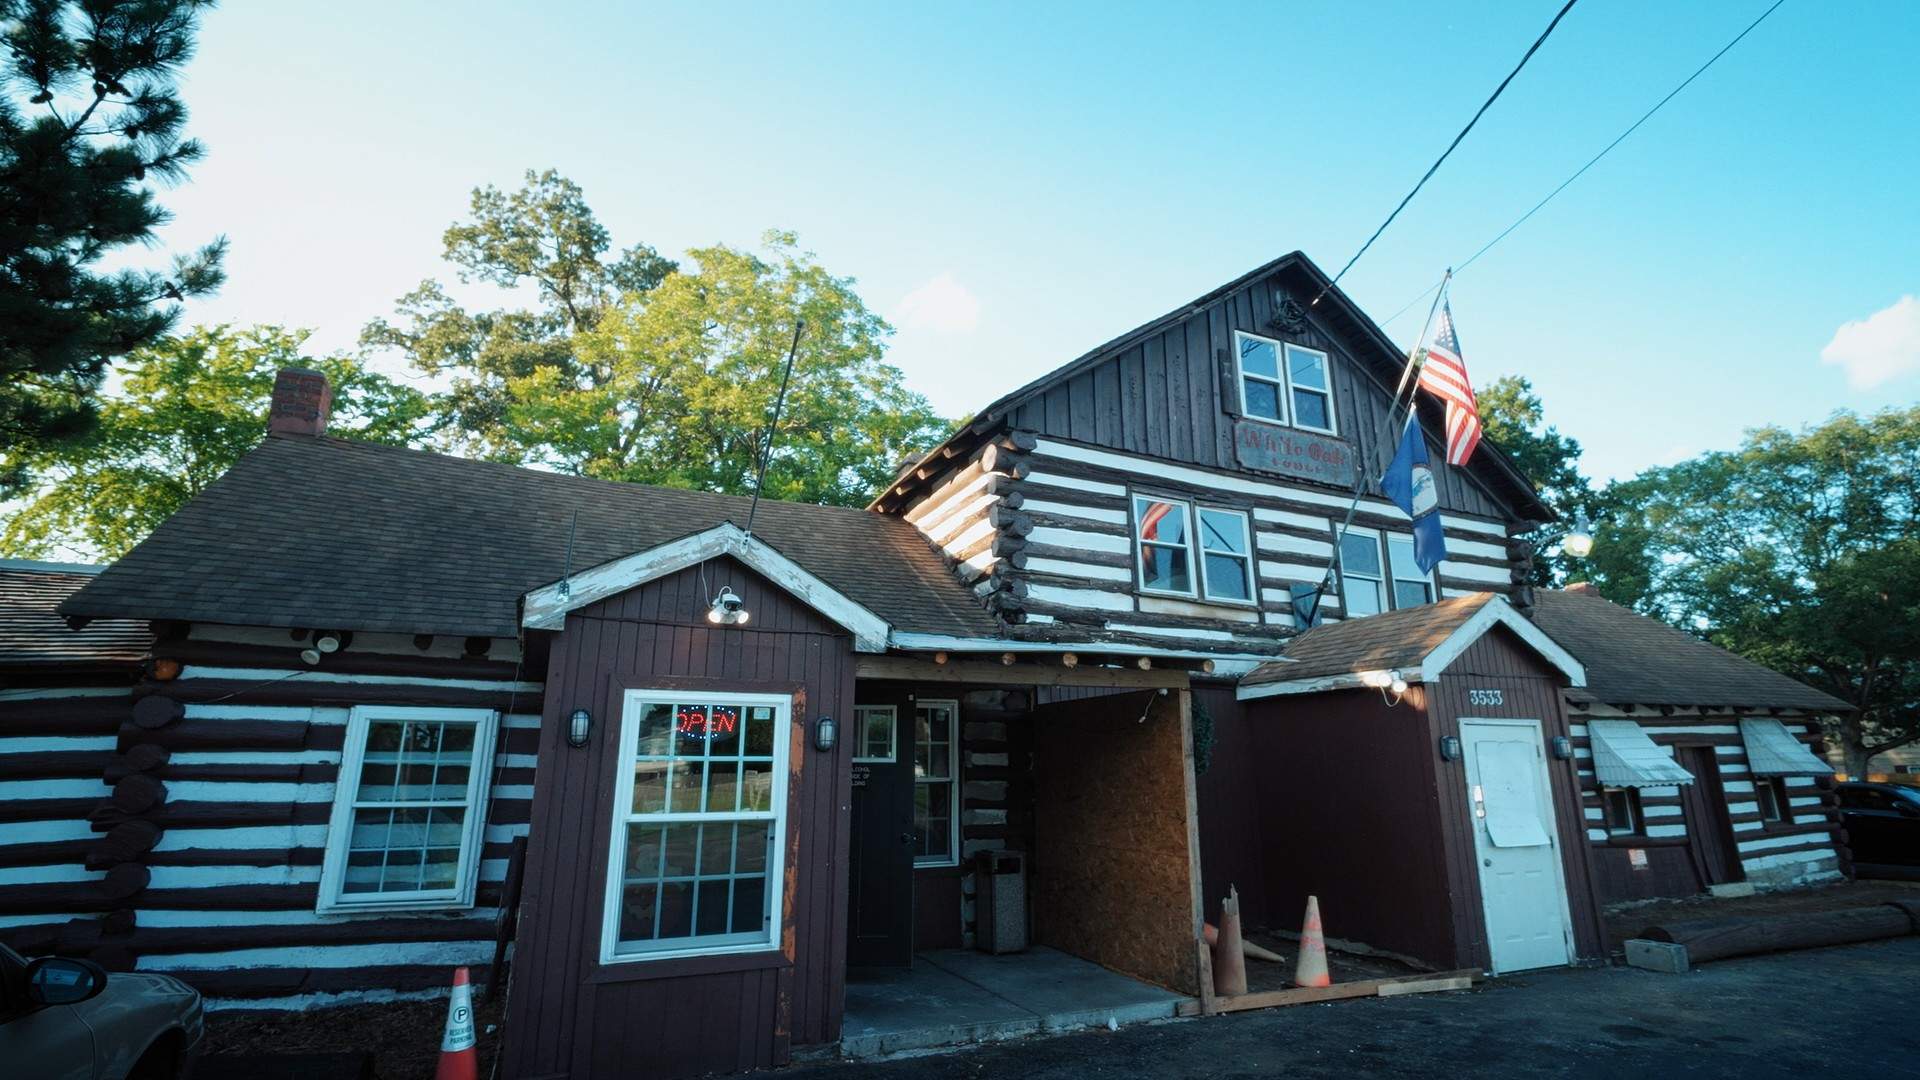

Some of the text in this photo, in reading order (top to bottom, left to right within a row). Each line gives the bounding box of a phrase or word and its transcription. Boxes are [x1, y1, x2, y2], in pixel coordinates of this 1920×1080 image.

[1470, 689, 1503, 705] 3533
[673, 712, 737, 732] OPEN
[457, 1008, 467, 1020] P
